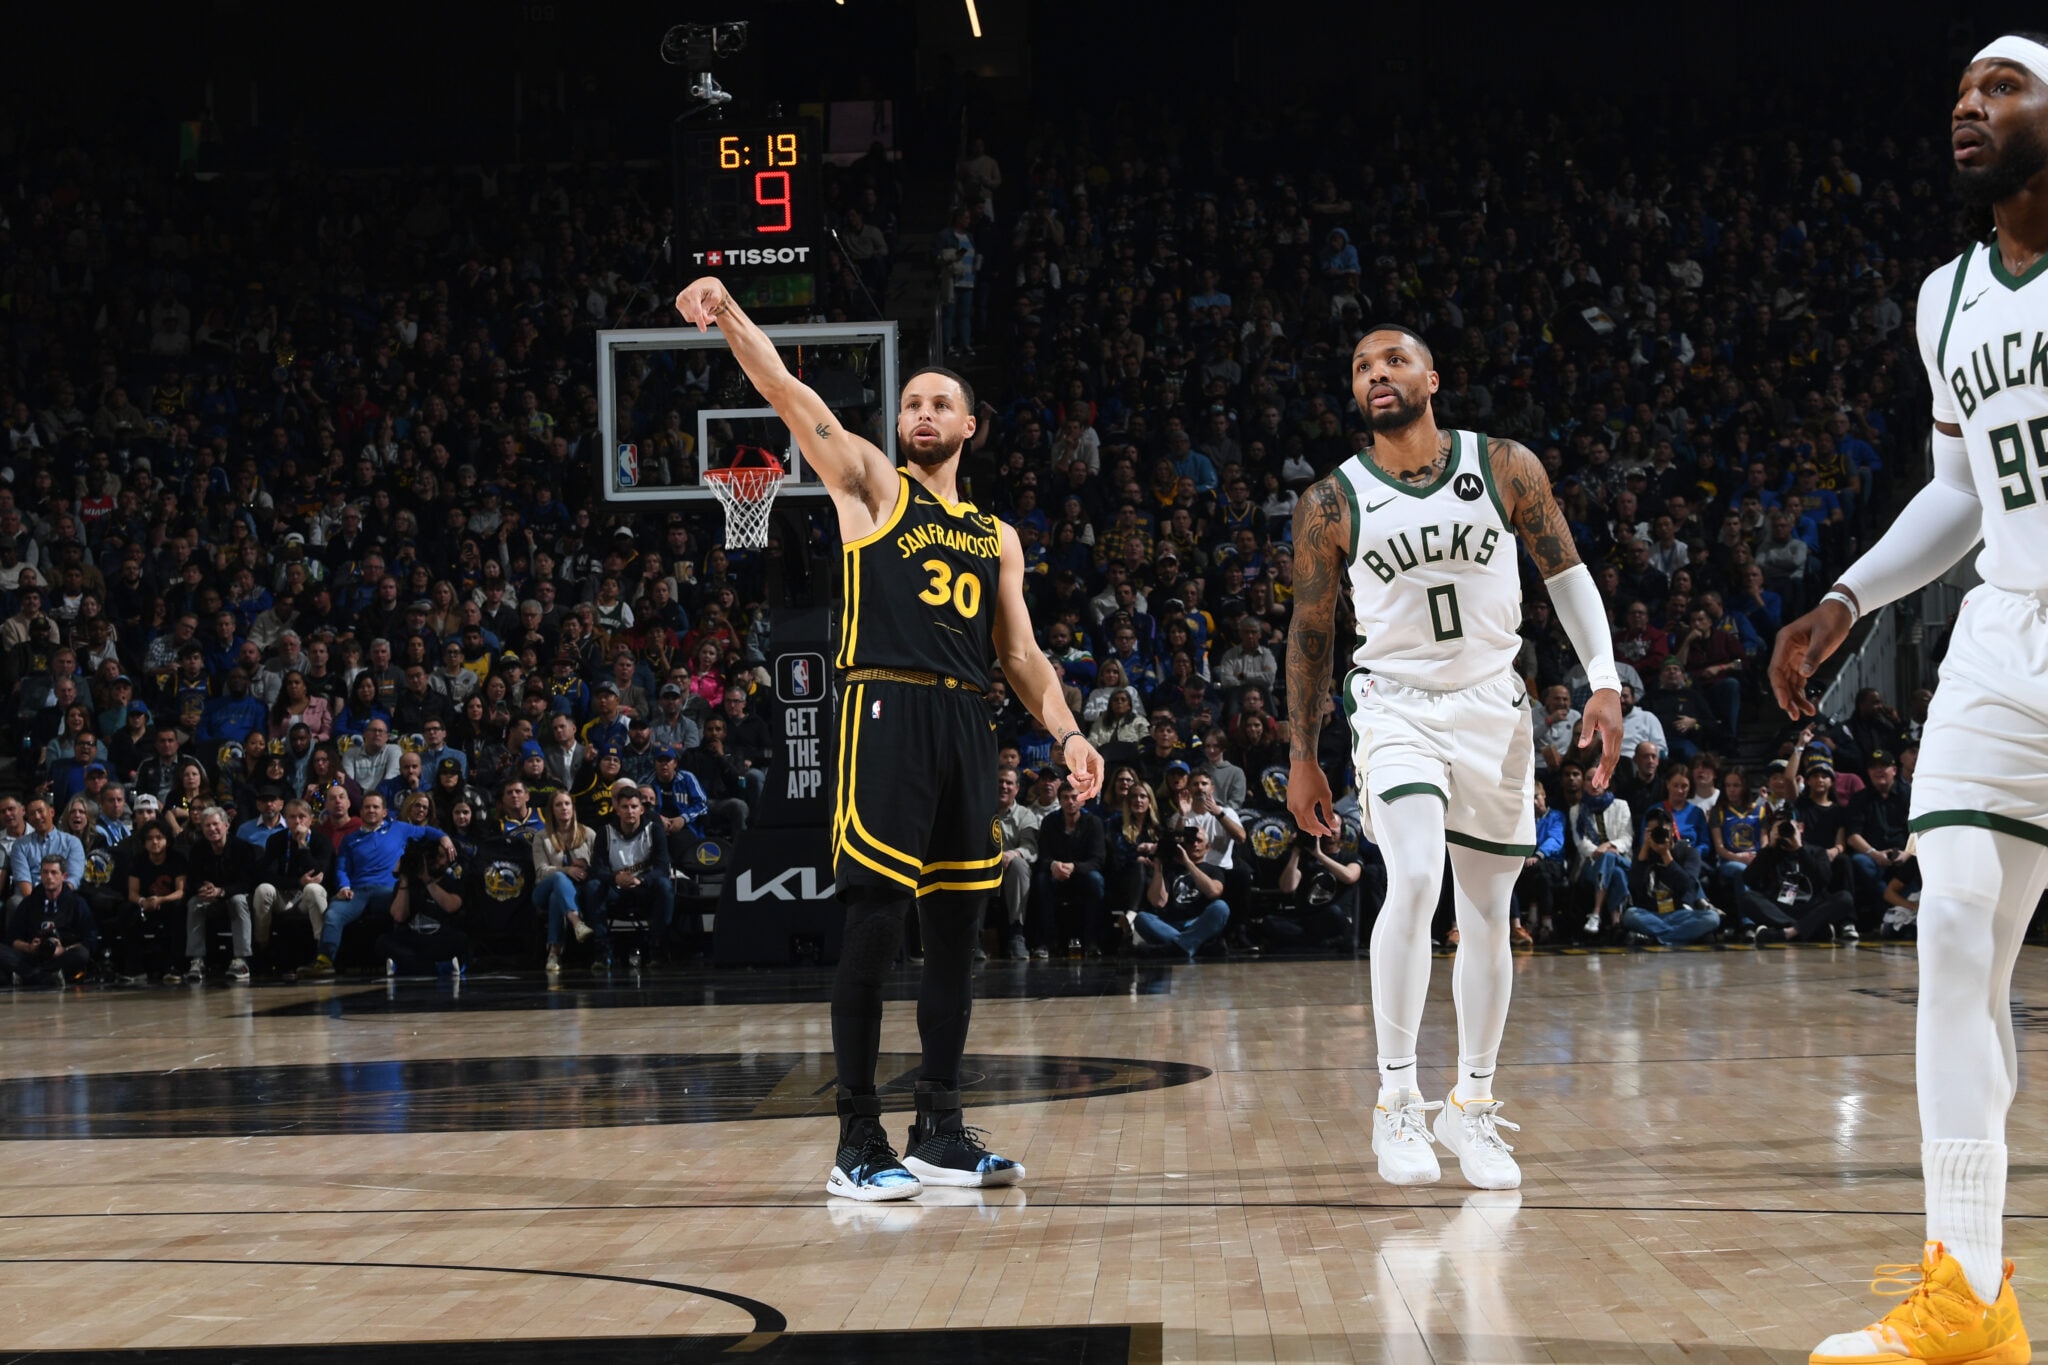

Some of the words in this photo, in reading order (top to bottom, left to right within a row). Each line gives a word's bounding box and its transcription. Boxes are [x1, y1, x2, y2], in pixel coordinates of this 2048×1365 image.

[755, 171, 792, 233] 9
[724, 246, 810, 265] TISSOT
[1362, 523, 1499, 584] BUCKS
[918, 559, 981, 619] 30
[1426, 583, 1464, 642] 0
[785, 707, 818, 737] GET
[786, 738, 820, 768] THE
[787, 769, 822, 799] APP
[736, 867, 836, 902] KI
